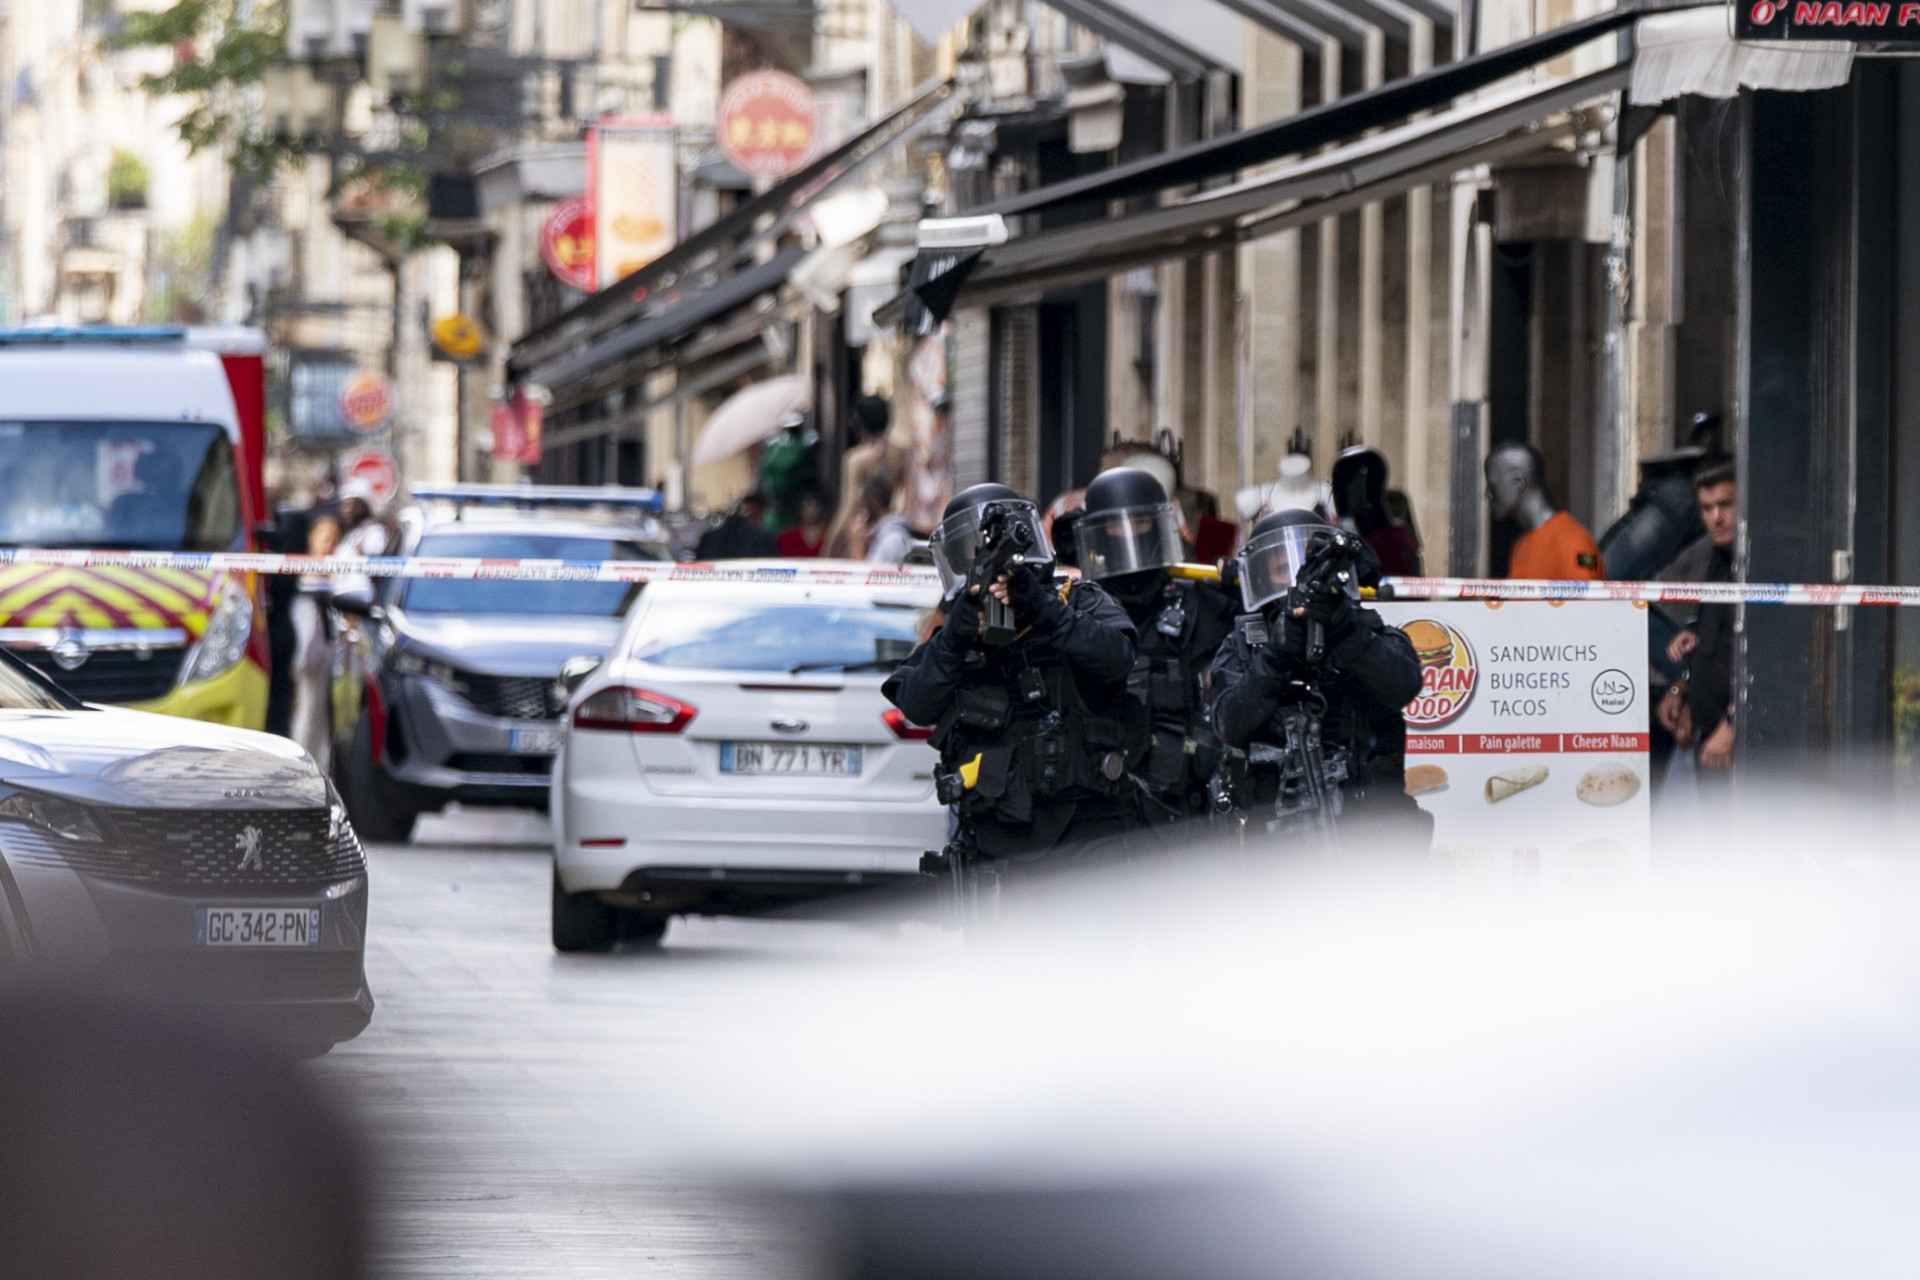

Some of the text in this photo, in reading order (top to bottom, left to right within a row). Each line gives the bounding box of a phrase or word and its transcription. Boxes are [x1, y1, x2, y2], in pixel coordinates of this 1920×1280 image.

[1794, 2, 1890, 25] NAAN
[1489, 645, 1598, 663] SANDWICHS
[1422, 667, 1475, 692] AAN
[1490, 672, 1571, 690] BURGERS
[1405, 697, 1453, 718] OOD
[1490, 699, 1547, 717] TACOS
[1601, 698, 1626, 706] Halal
[1407, 736, 1445, 750] maison
[1479, 735, 1542, 753] Pain galette
[1572, 734, 1638, 749] Cheese Naan
